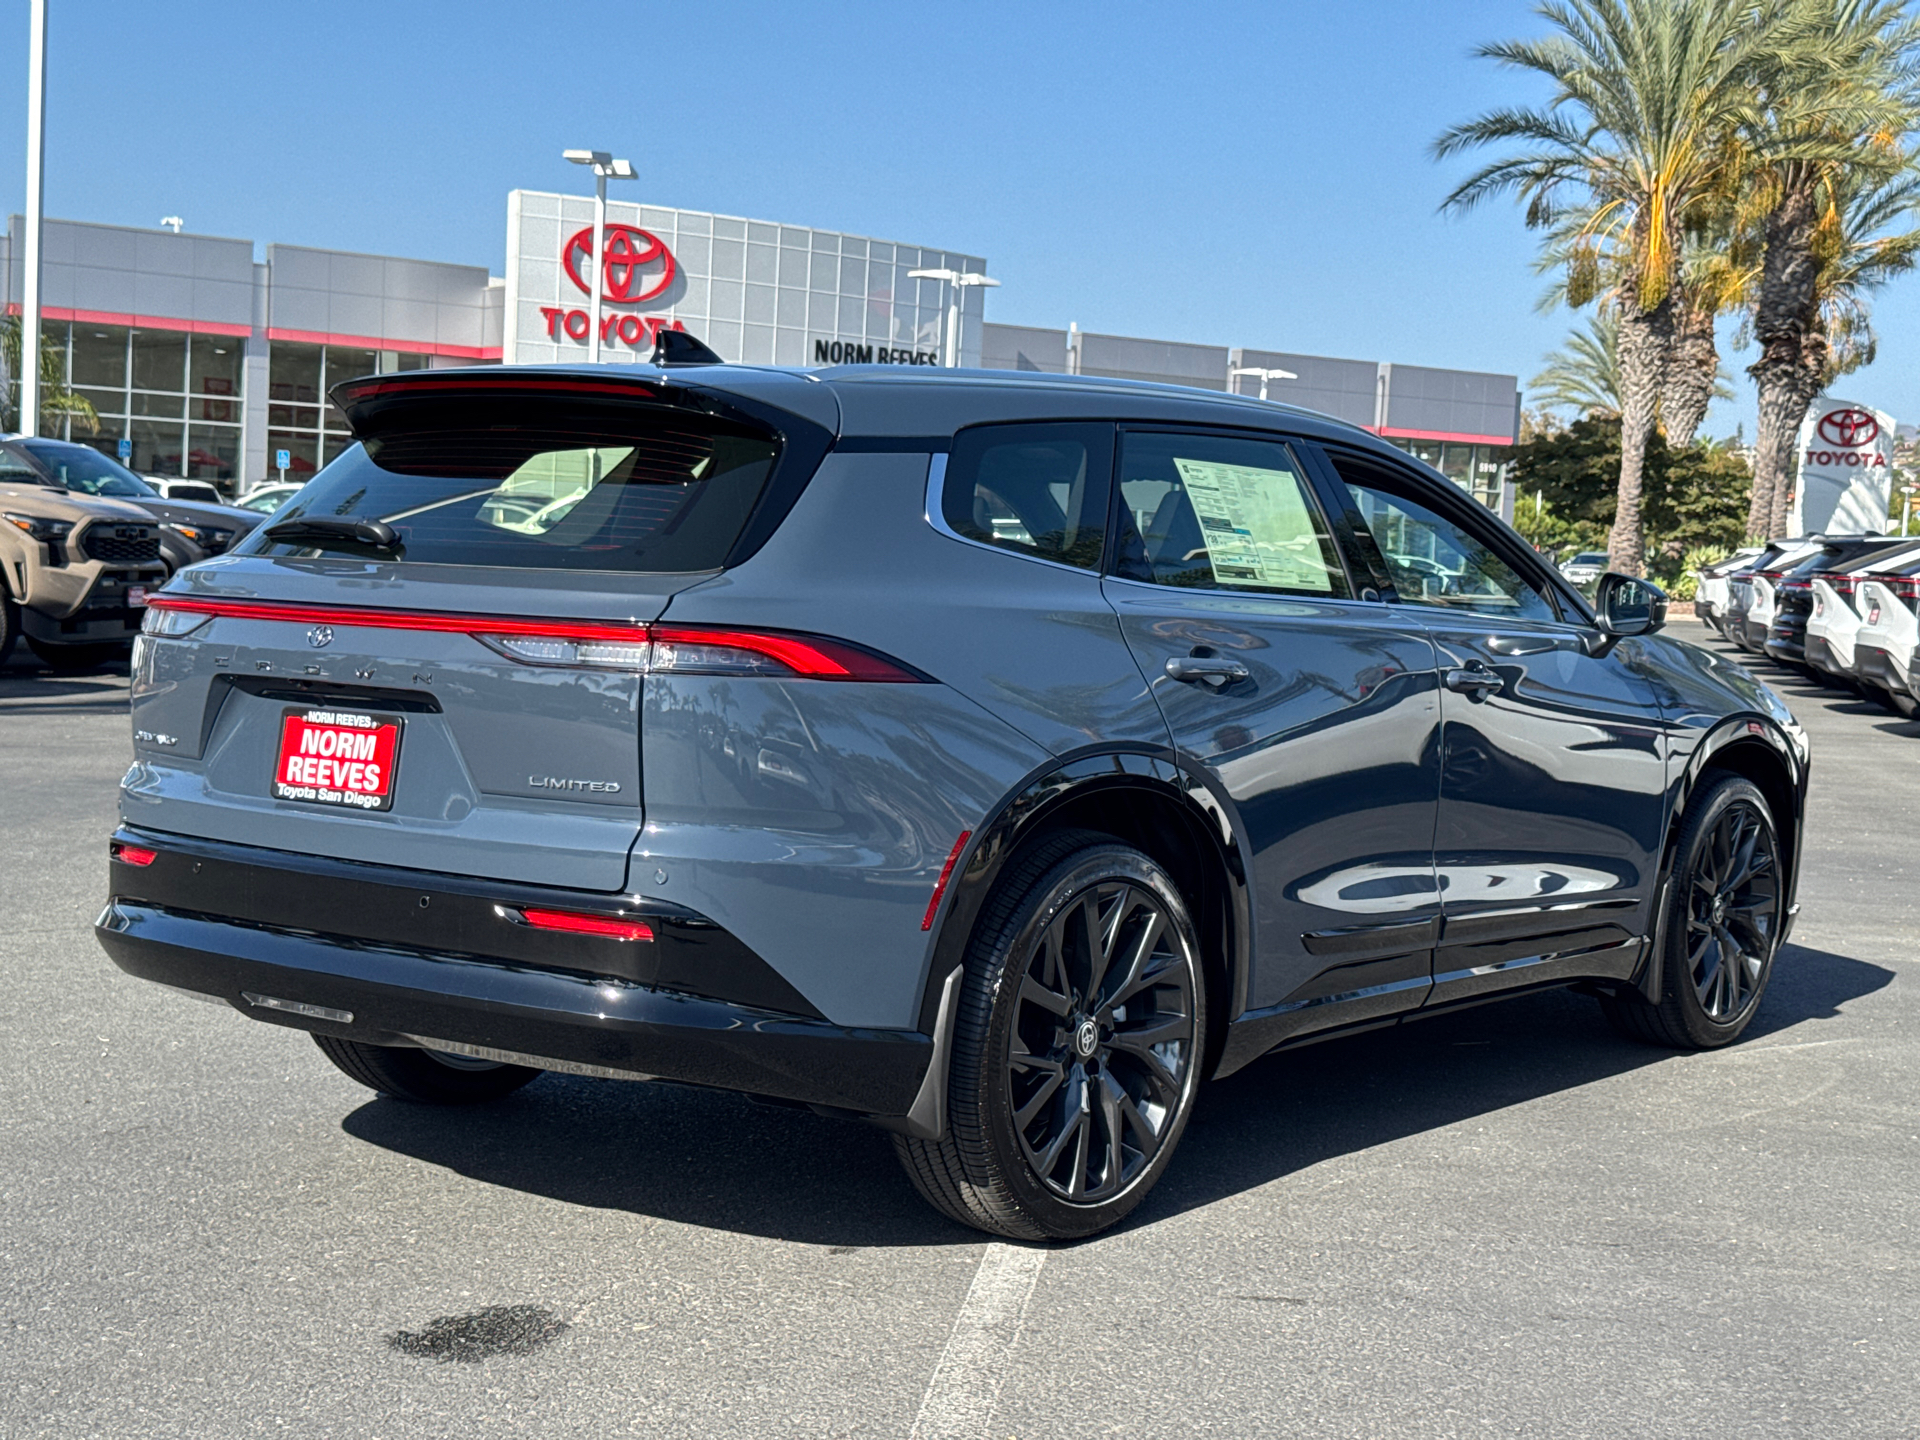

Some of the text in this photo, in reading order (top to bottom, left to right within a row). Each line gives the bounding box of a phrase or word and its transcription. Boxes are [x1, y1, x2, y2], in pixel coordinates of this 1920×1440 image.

[815, 339, 873, 365] NORM
[1806, 451, 1886, 468] TOYOTA
[214, 656, 433, 685] CROWN
[308, 711, 372, 728] NORM REEVES
[300, 728, 377, 761] NORM
[286, 756, 380, 791] REEVES
[528, 775, 621, 793] LIMITED
[277, 783, 381, 808] Toyota San Diego
